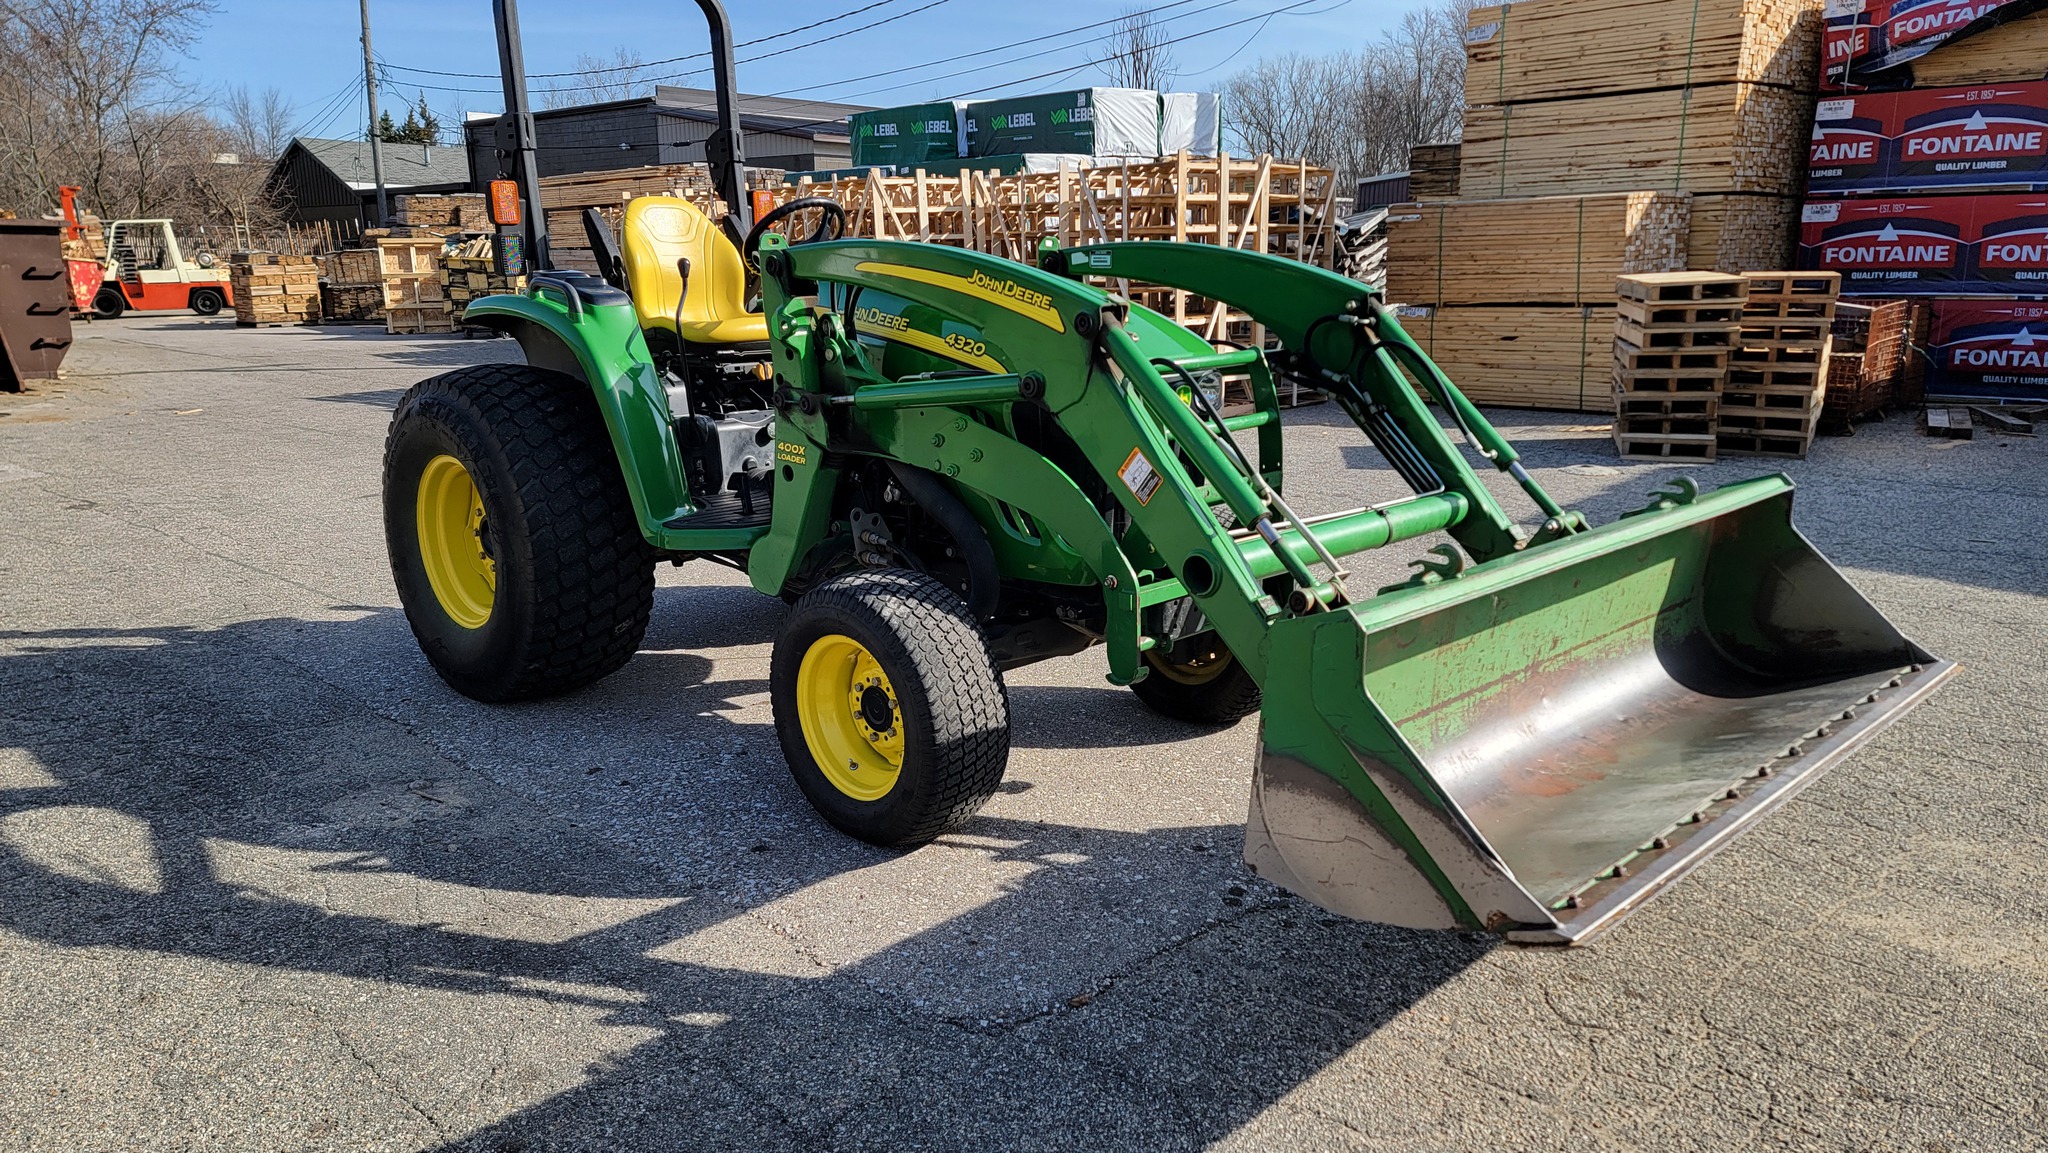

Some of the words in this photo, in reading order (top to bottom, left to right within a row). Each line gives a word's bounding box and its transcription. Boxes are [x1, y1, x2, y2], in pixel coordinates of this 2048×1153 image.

[1827, 33, 1865, 59] INE
[1827, 66, 1844, 75] BER
[1966, 91, 1979, 100] EST.
[1980, 90, 1995, 100] 1957
[1008, 112, 1036, 128] LEBEL
[1069, 107, 1094, 123] LEBE
[874, 123, 900, 137] LEBEL
[925, 120, 952, 134] LEBEL
[1907, 132, 2042, 156] FONTAINE
[1811, 168, 1843, 178] LUMBER
[1935, 162, 1970, 172] QUALITY
[1972, 161, 2007, 170] LUMBER
[1879, 204, 1891, 213] EST.
[1892, 204, 1905, 213] 1957
[1825, 245, 1950, 263] FONTAINE
[1851, 271, 1884, 280] QUALITY
[1885, 271, 1918, 279] LUMBER
[967, 269, 1005, 294] JOHN
[1004, 281, 1053, 309] DEERE
[868, 307, 910, 332] DEERE
[2014, 308, 2027, 317] EST.
[2028, 308, 2043, 317] 1957
[944, 333, 986, 357] 4320
[1982, 375, 2018, 383] QUALITY
[778, 441, 806, 456] 400X
[777, 453, 806, 465] LOADER
